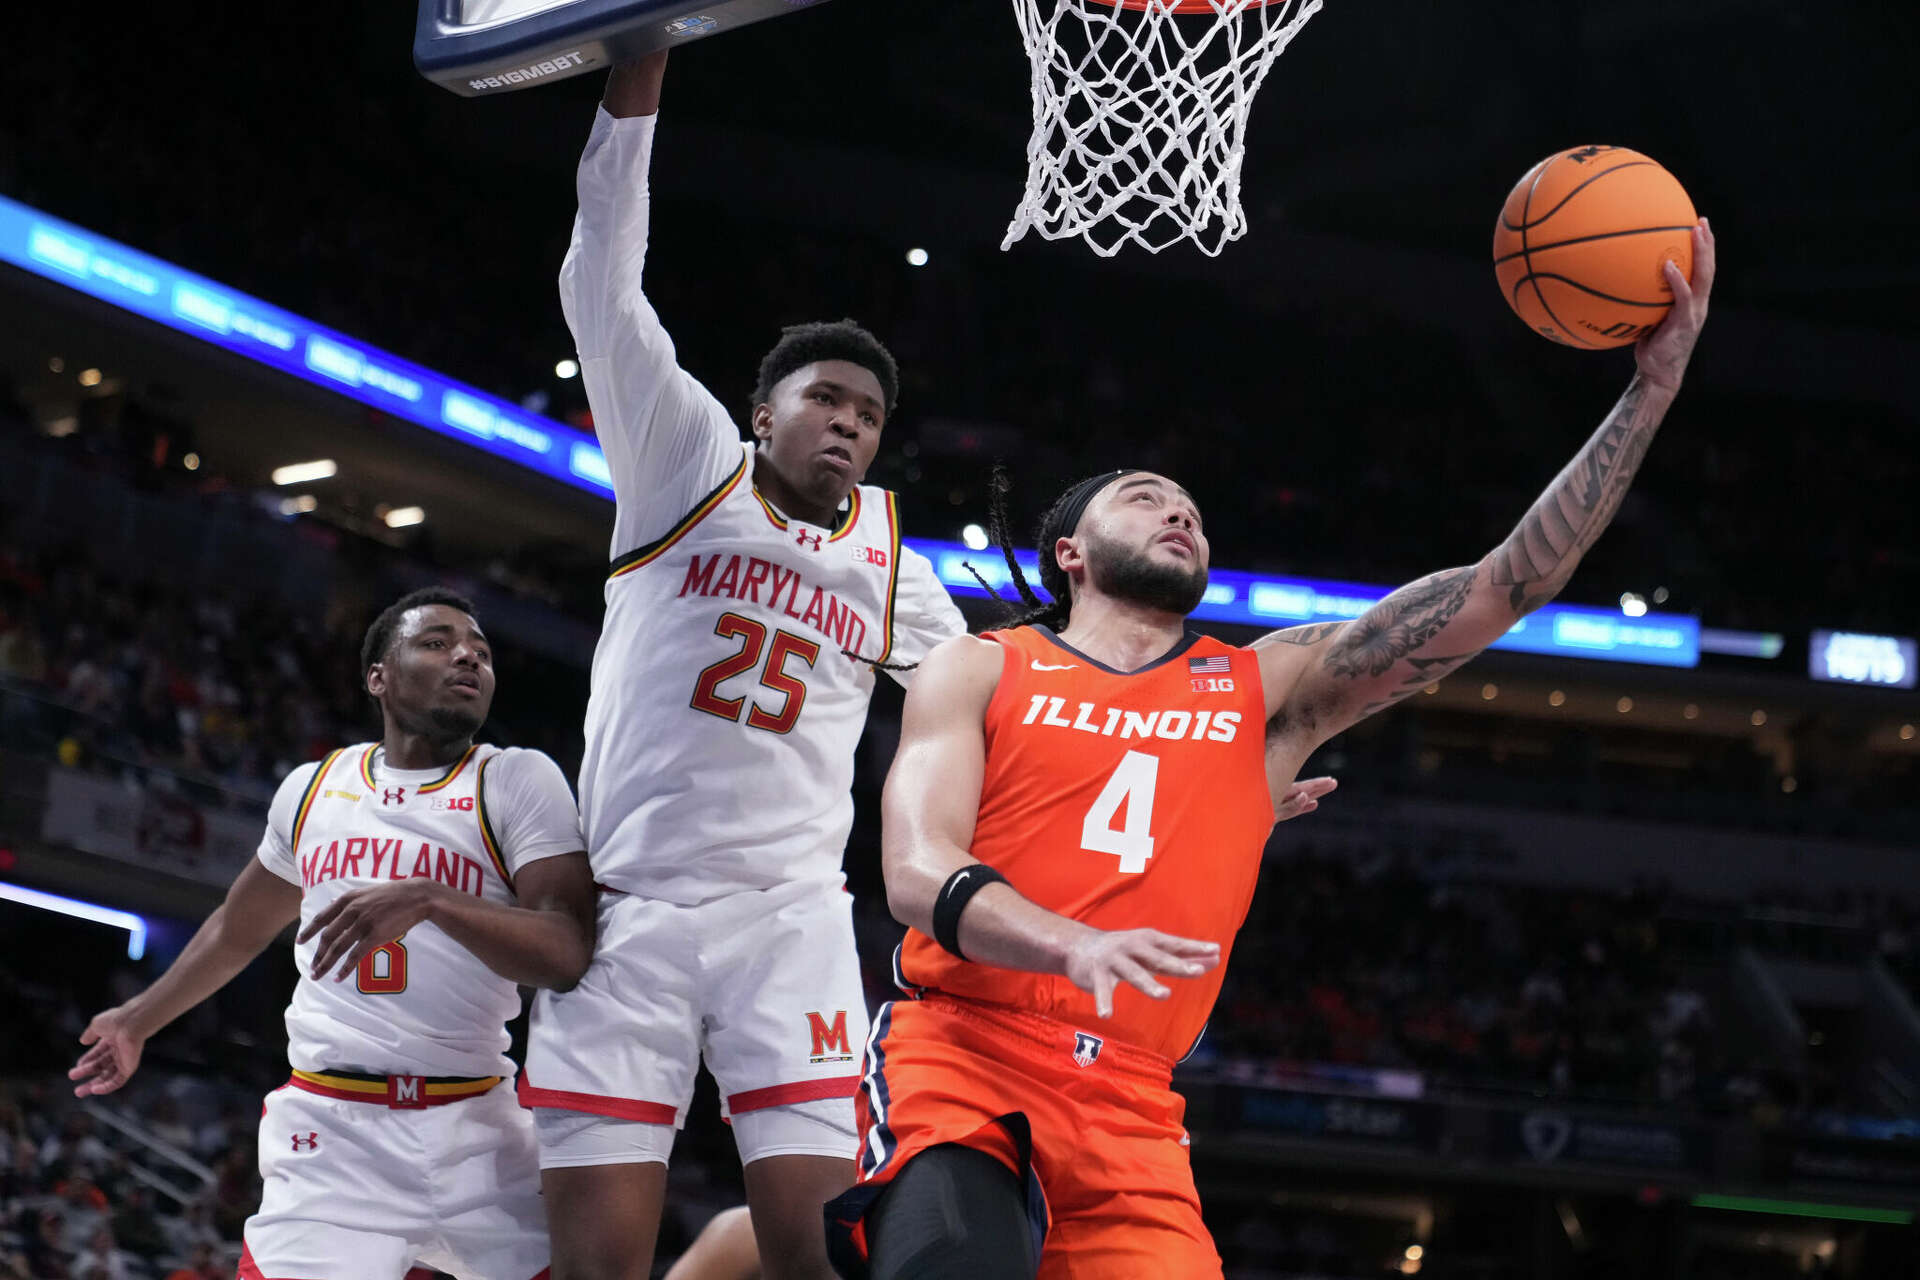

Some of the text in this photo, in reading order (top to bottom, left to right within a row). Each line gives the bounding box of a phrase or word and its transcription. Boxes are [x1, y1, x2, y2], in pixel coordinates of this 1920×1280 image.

[469, 51, 583, 90] #B1GMBBT
[676, 553, 866, 663] MARYLAND
[689, 611, 821, 735] 25
[1022, 694, 1242, 743] ILLINOIS
[1080, 749, 1159, 873] 4
[301, 837, 484, 898] MARYLAND
[805, 1010, 852, 1056] M
[396, 1077, 419, 1101] M
